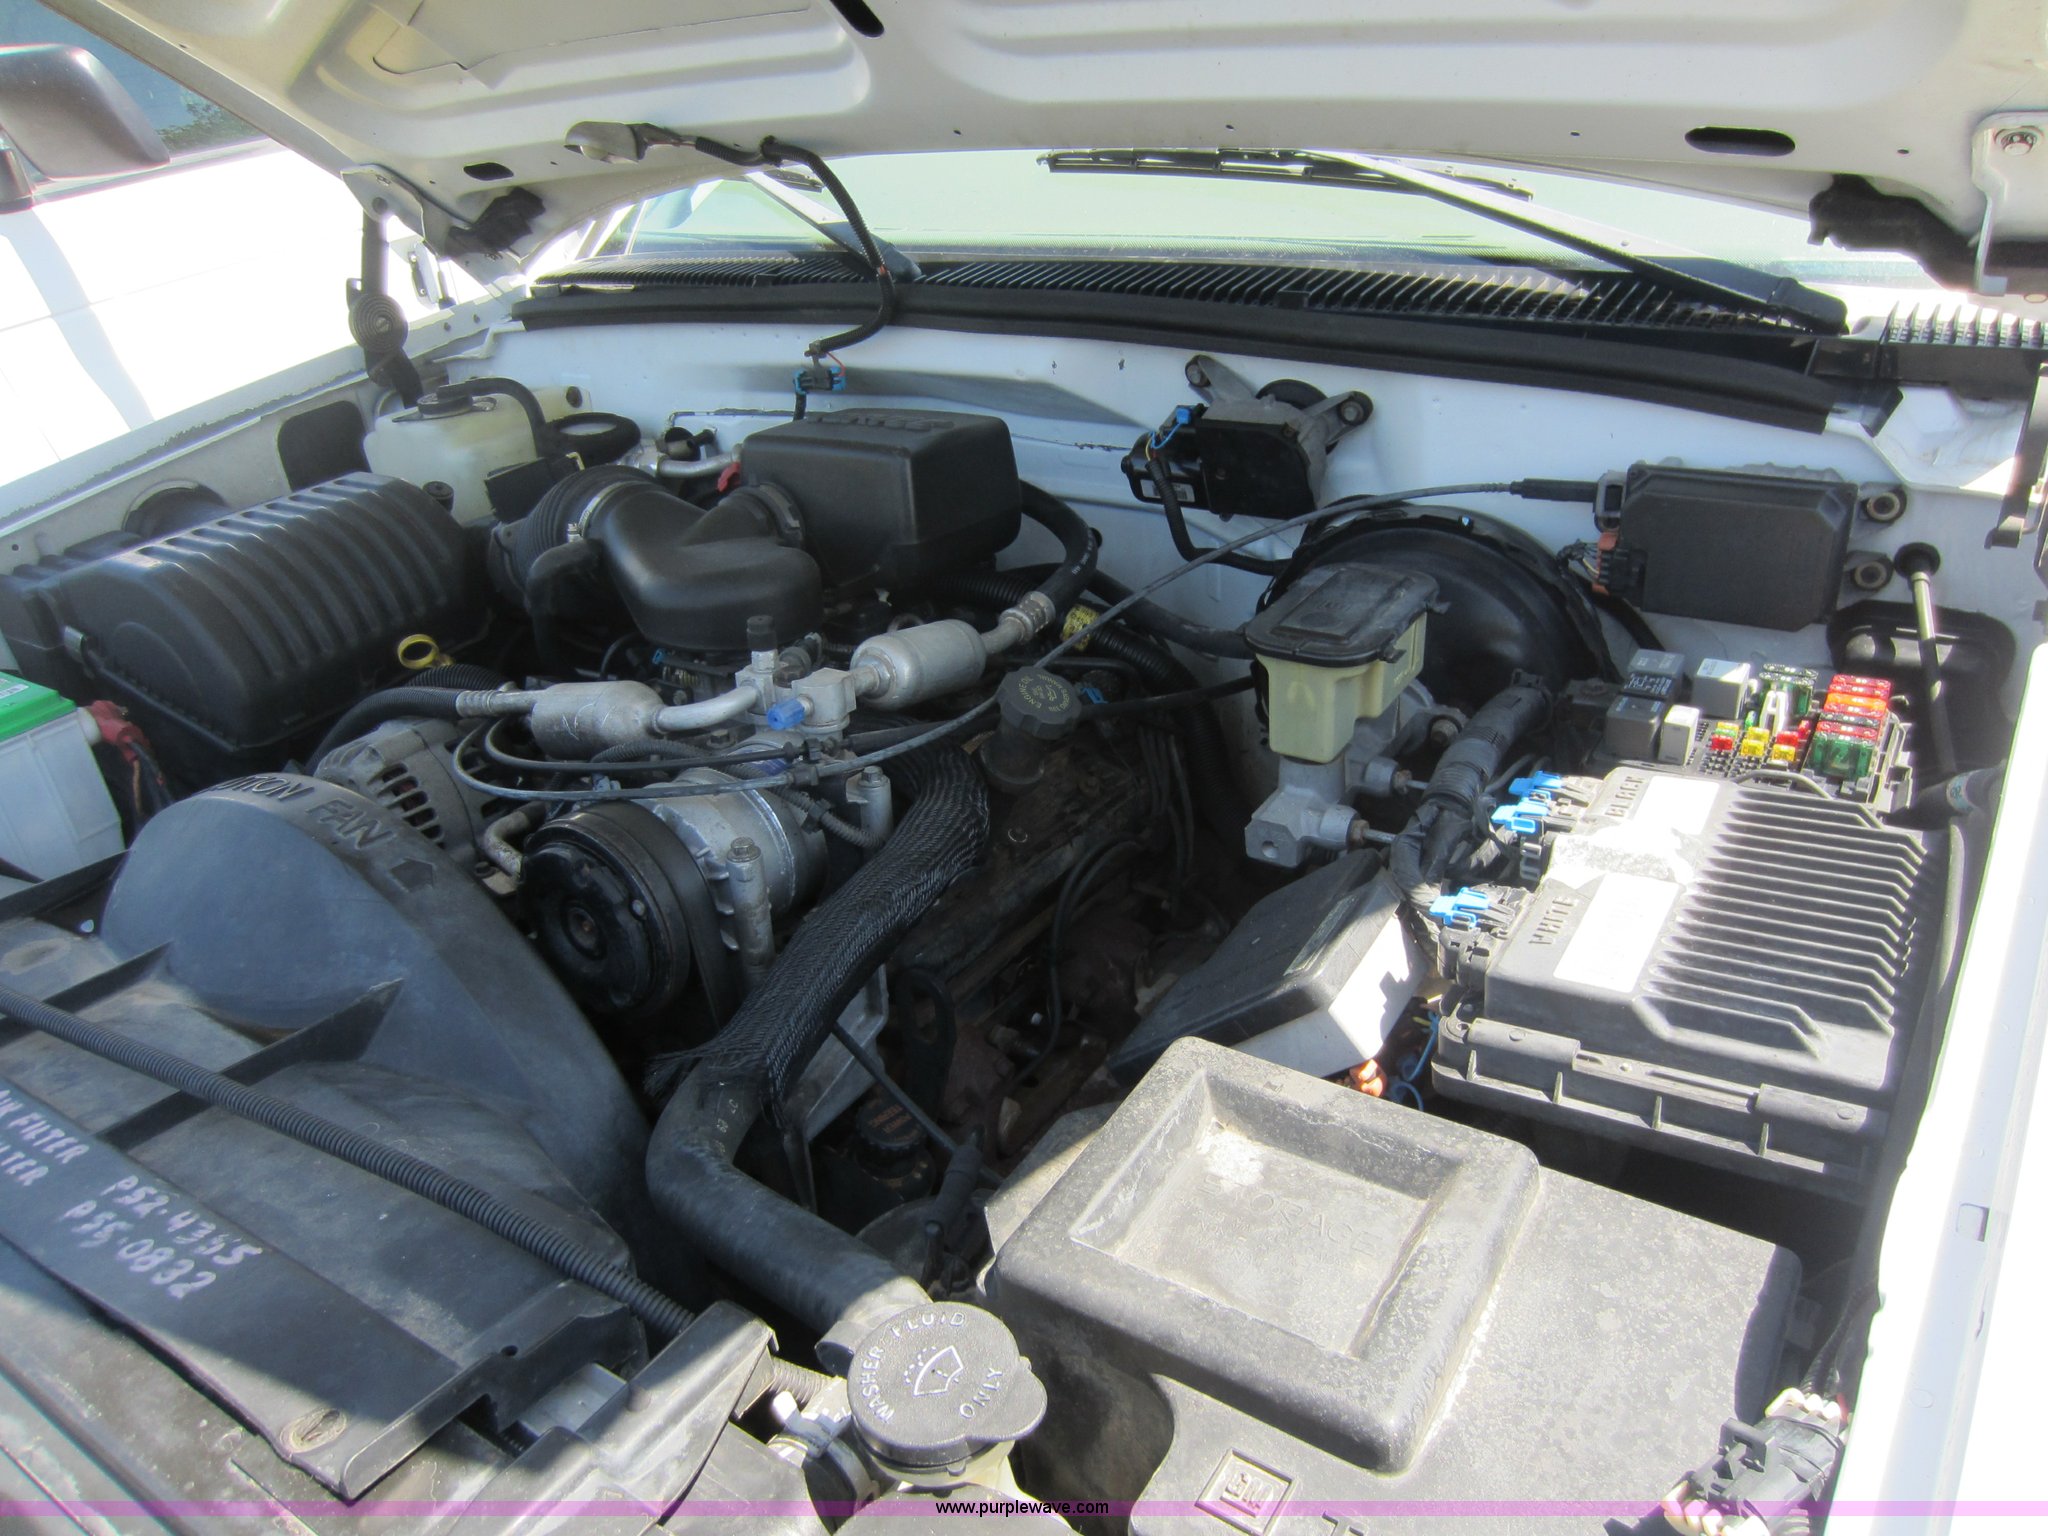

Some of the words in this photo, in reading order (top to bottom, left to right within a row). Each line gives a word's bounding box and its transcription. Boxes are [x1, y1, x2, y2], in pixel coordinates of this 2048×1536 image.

[1604, 775, 1646, 818] BLACK
[305, 798, 396, 850] FAN
[1527, 895, 1577, 945] WHITE
[6, 1111, 91, 1165] FILTER
[860, 1345, 896, 1424] WASHER
[890, 1311, 966, 1339] FLUID
[958, 1366, 1004, 1420] ONLY
